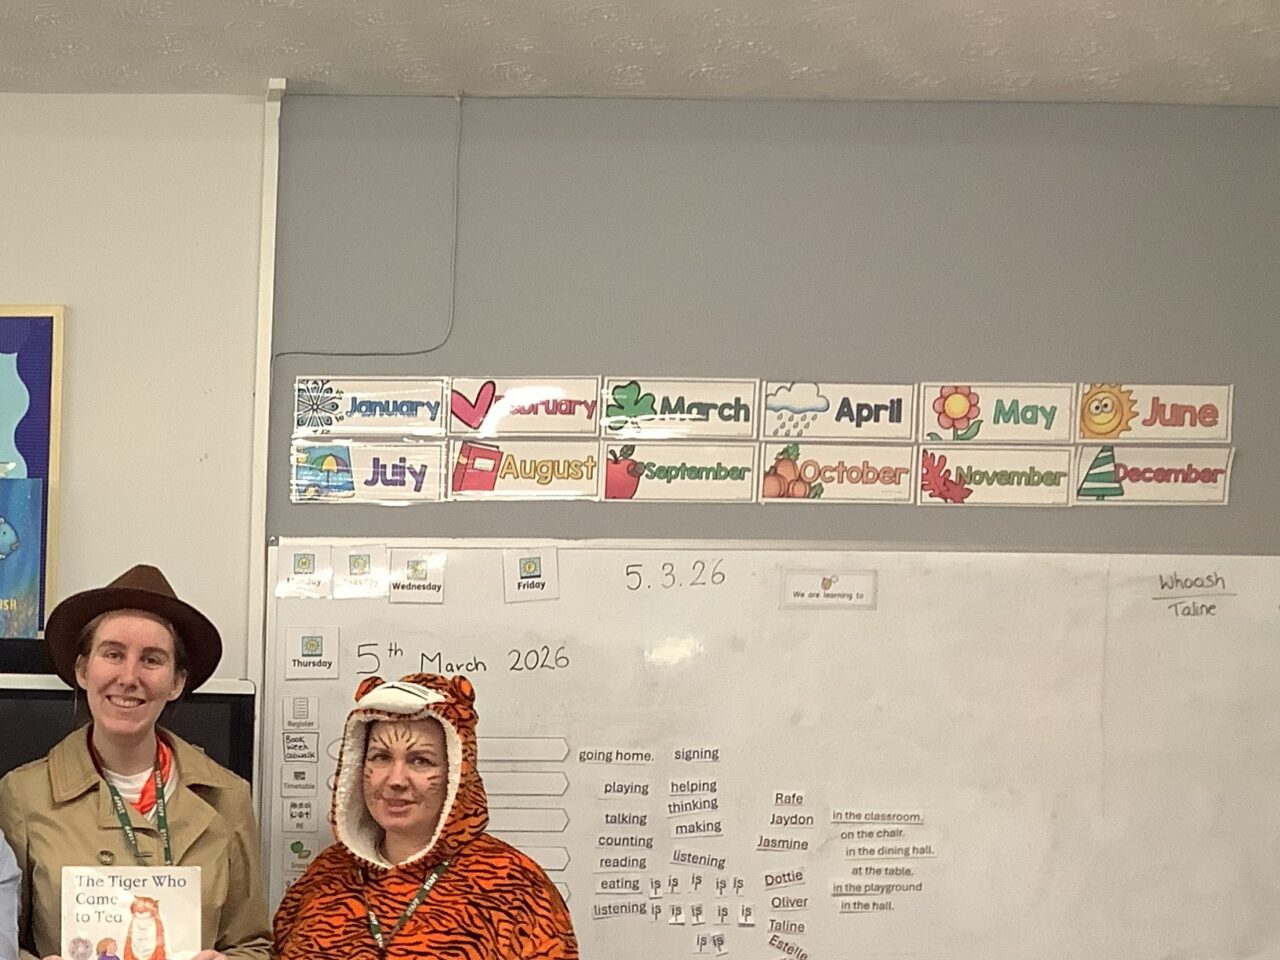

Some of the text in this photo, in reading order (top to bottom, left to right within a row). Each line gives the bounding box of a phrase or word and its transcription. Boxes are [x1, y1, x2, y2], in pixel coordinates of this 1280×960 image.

[345, 397, 440, 422] January
[659, 396, 751, 422] March
[835, 396, 902, 428] April
[992, 398, 1057, 431] May
[1141, 396, 1220, 427] June
[363, 456, 428, 493] July
[499, 454, 596, 485] August
[644, 461, 752, 484] September
[800, 459, 910, 485] October
[955, 465, 1067, 487] November
[1113, 463, 1227, 484] December
[517, 580, 546, 595] Friday
[1158, 571, 1226, 590] Whoosh
[392, 582, 442, 597] Wednesday
[793, 591, 805, 599] We
[823, 591, 853, 601] learning
[856, 591, 865, 600] to
[1168, 600, 1217, 617] Taline
[292, 659, 333, 674] Thursday
[420, 652, 487, 674] March
[508, 645, 571, 671] 2026
[579, 750, 655, 763] going home.
[674, 748, 720, 762] signing
[604, 781, 649, 796] playing
[671, 780, 718, 794] helping
[775, 792, 804, 804] Rafe
[667, 798, 719, 814] thinking
[605, 812, 648, 826] talking
[770, 813, 814, 826] Jaydon
[832, 810, 842, 820] in
[845, 811, 862, 820] the
[675, 821, 723, 835] making
[840, 831, 854, 840] on
[857, 830, 874, 839] the
[598, 835, 654, 849] counting
[757, 835, 809, 850] Jasmine
[845, 847, 856, 857] in
[858, 846, 875, 856] the
[877, 845, 910, 857] dining
[599, 856, 647, 870] reading
[672, 849, 726, 870] listening
[764, 870, 803, 886] Dottie
[851, 867, 914, 876] at the table.
[75, 875, 187, 891] The Tiger Who
[600, 877, 640, 891] eating
[650, 877, 662, 890] is
[668, 875, 679, 888] is
[691, 873, 702, 886] is
[715, 878, 726, 891] is
[733, 877, 744, 889] is
[833, 882, 923, 895] in the playground
[75, 892, 118, 906] Came
[771, 896, 808, 908] Oliver
[841, 901, 851, 910] in
[853, 901, 870, 910] the
[594, 902, 647, 916] listening
[651, 903, 662, 915] is
[671, 905, 682, 917] is
[691, 904, 703, 917] is
[717, 905, 729, 917] is
[741, 904, 752, 918] is
[75, 911, 123, 923] to Tea
[769, 918, 805, 932] Taline
[696, 934, 708, 946] is
[712, 934, 724, 947] is
